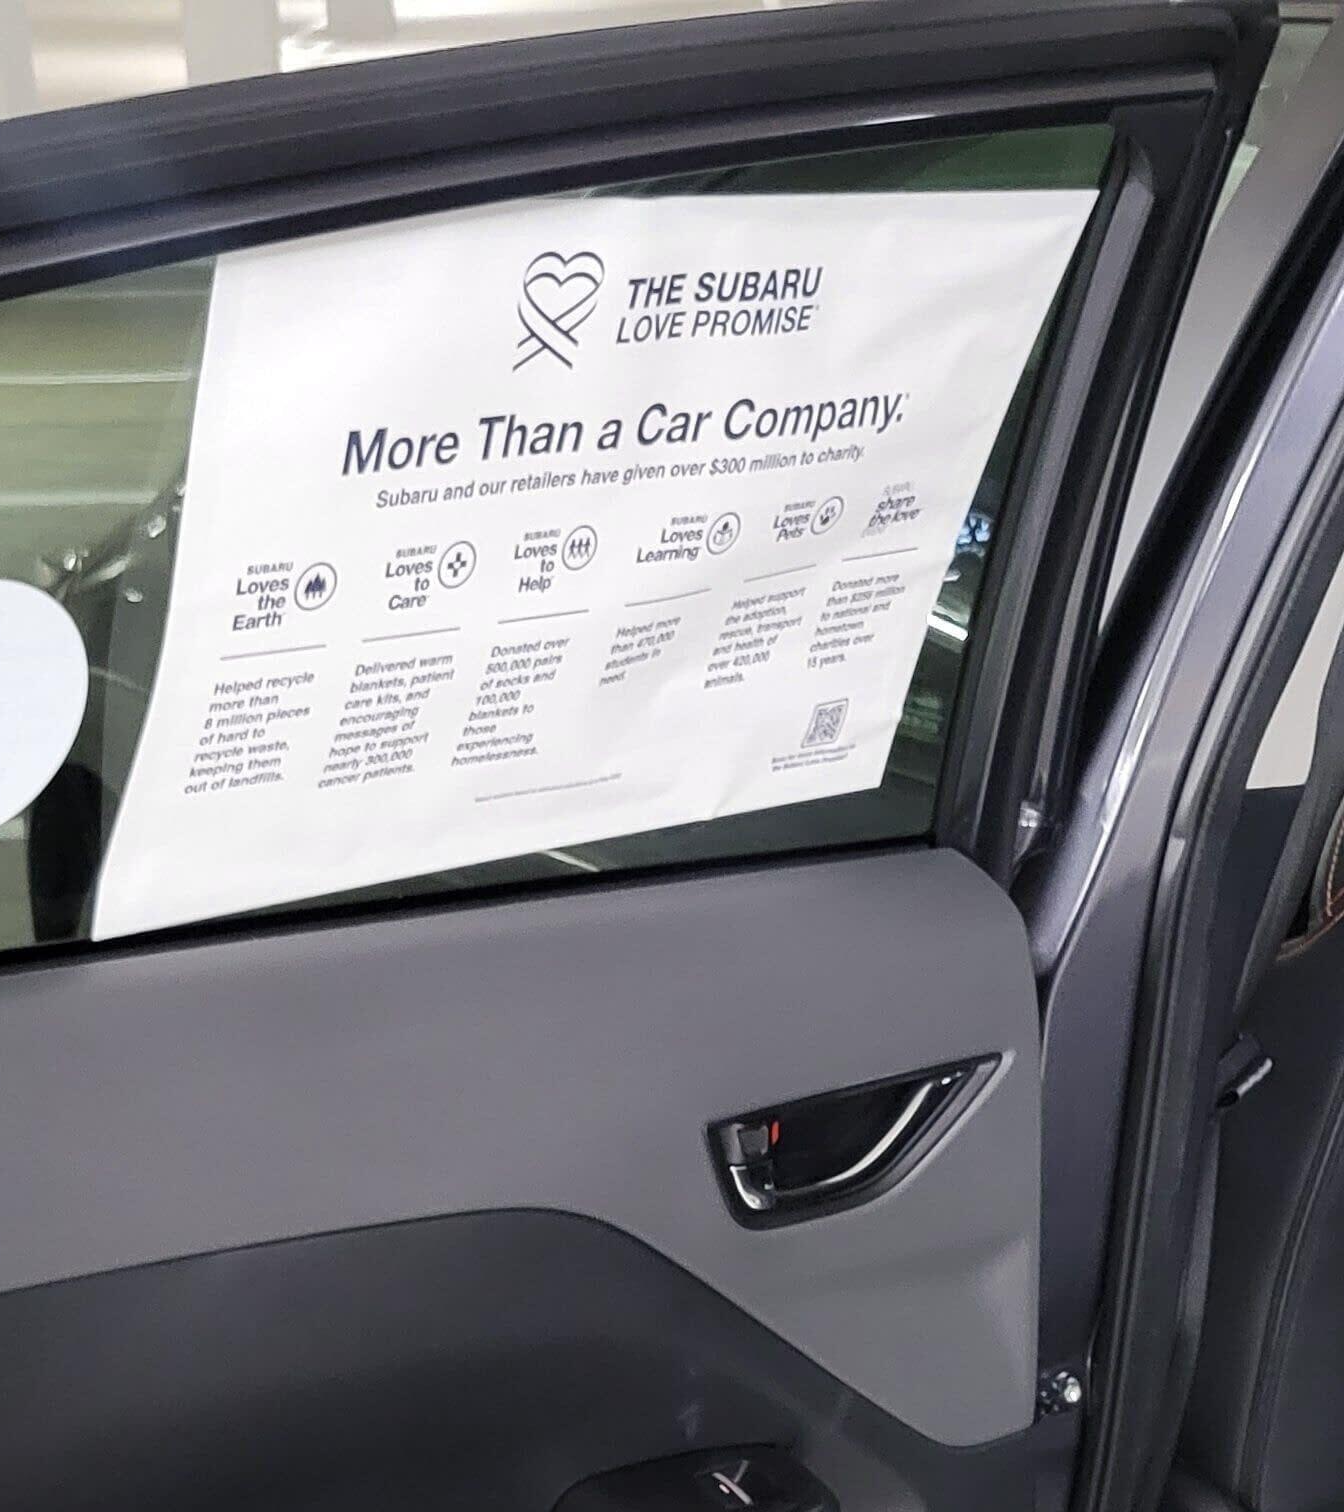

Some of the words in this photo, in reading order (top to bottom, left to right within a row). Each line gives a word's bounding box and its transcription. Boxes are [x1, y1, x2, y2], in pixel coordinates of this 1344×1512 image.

[629, 273, 687, 309] THE
[694, 267, 823, 302] SUBARU
[616, 311, 686, 344] LOVE
[691, 304, 814, 338] PROMISE
[342, 427, 460, 476] More
[478, 414, 583, 460] Than
[597, 419, 622, 450] a
[637, 403, 712, 446] Car
[724, 392, 904, 443] Company.
[375, 489, 438, 508] Subaru
[443, 480, 475, 501] and
[479, 479, 507, 497] our
[510, 470, 576, 493] retailers
[580, 468, 620, 486] have
[622, 463, 665, 485] given
[670, 460, 706, 477] over
[709, 456, 746, 476] $300
[749, 453, 796, 472] million
[800, 451, 814, 466] to
[818, 444, 864, 464] charity.
[773, 513, 810, 529] Loves
[660, 528, 703, 544] Loves
[396, 544, 437, 559] SUBARU
[514, 543, 557, 560] Loves
[636, 545, 700, 563] Learning
[247, 561, 293, 575] SUBARU
[385, 560, 433, 578] Loves
[540, 558, 555, 573] to
[236, 578, 289, 596] Loves
[414, 577, 430, 592] to
[518, 575, 552, 593] Help
[258, 594, 286, 611] the
[388, 594, 427, 610] Care
[232, 611, 282, 631] Earth
[491, 640, 542, 658] Donated
[355, 656, 416, 677] Delivered
[419, 654, 453, 668] warm
[213, 677, 263, 696] Helped
[266, 671, 315, 689] recycle
[410, 668, 455, 689] patient
[209, 699, 245, 713] more
[249, 694, 279, 708] than
[344, 698, 372, 710] care
[405, 688, 431, 702] and
[216, 712, 263, 728] million
[266, 705, 311, 724] pieces
[339, 706, 419, 727] encouraging
[468, 706, 519, 721] blankets
[199, 732, 214, 746] of
[216, 728, 249, 744] hard
[252, 727, 265, 740] to
[334, 724, 398, 743] messages
[401, 720, 416, 732] of
[194, 745, 243, 763] recycle
[329, 745, 361, 759] hope
[365, 741, 376, 753] to
[380, 732, 429, 749] support
[189, 762, 243, 778] keeping
[248, 757, 281, 771] them
[323, 758, 362, 774] nearly
[184, 781, 207, 794] out
[210, 778, 225, 791] of
[318, 773, 361, 789] cancer
